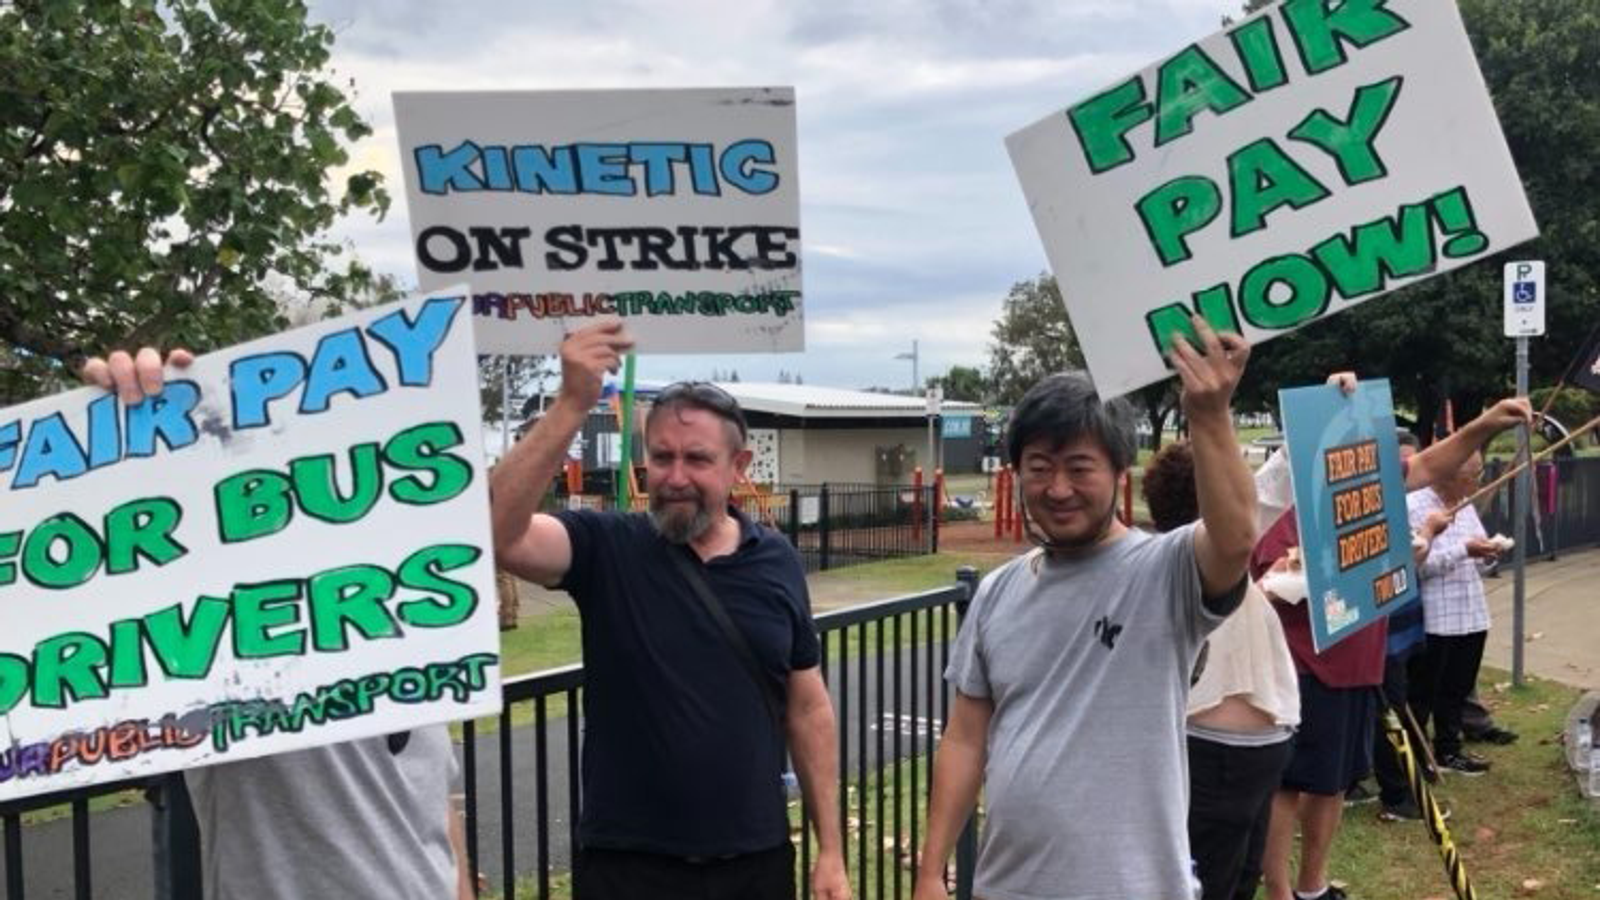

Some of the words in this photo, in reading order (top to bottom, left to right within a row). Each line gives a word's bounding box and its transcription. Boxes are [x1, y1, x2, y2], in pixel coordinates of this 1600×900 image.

[1066, 0, 1412, 174] FAIR
[413, 139, 780, 197] KINETIC
[1133, 75, 1404, 267] PAY
[416, 226, 531, 273] ON
[545, 224, 800, 271] STRIKE
[1145, 185, 1489, 370] NOW!
[229, 296, 466, 431] PAY
[213, 421, 475, 544] BUS
[1327, 449, 1356, 481] FAIR
[1335, 488, 1361, 525] FOR
[1340, 522, 1388, 569] DRIVERS
